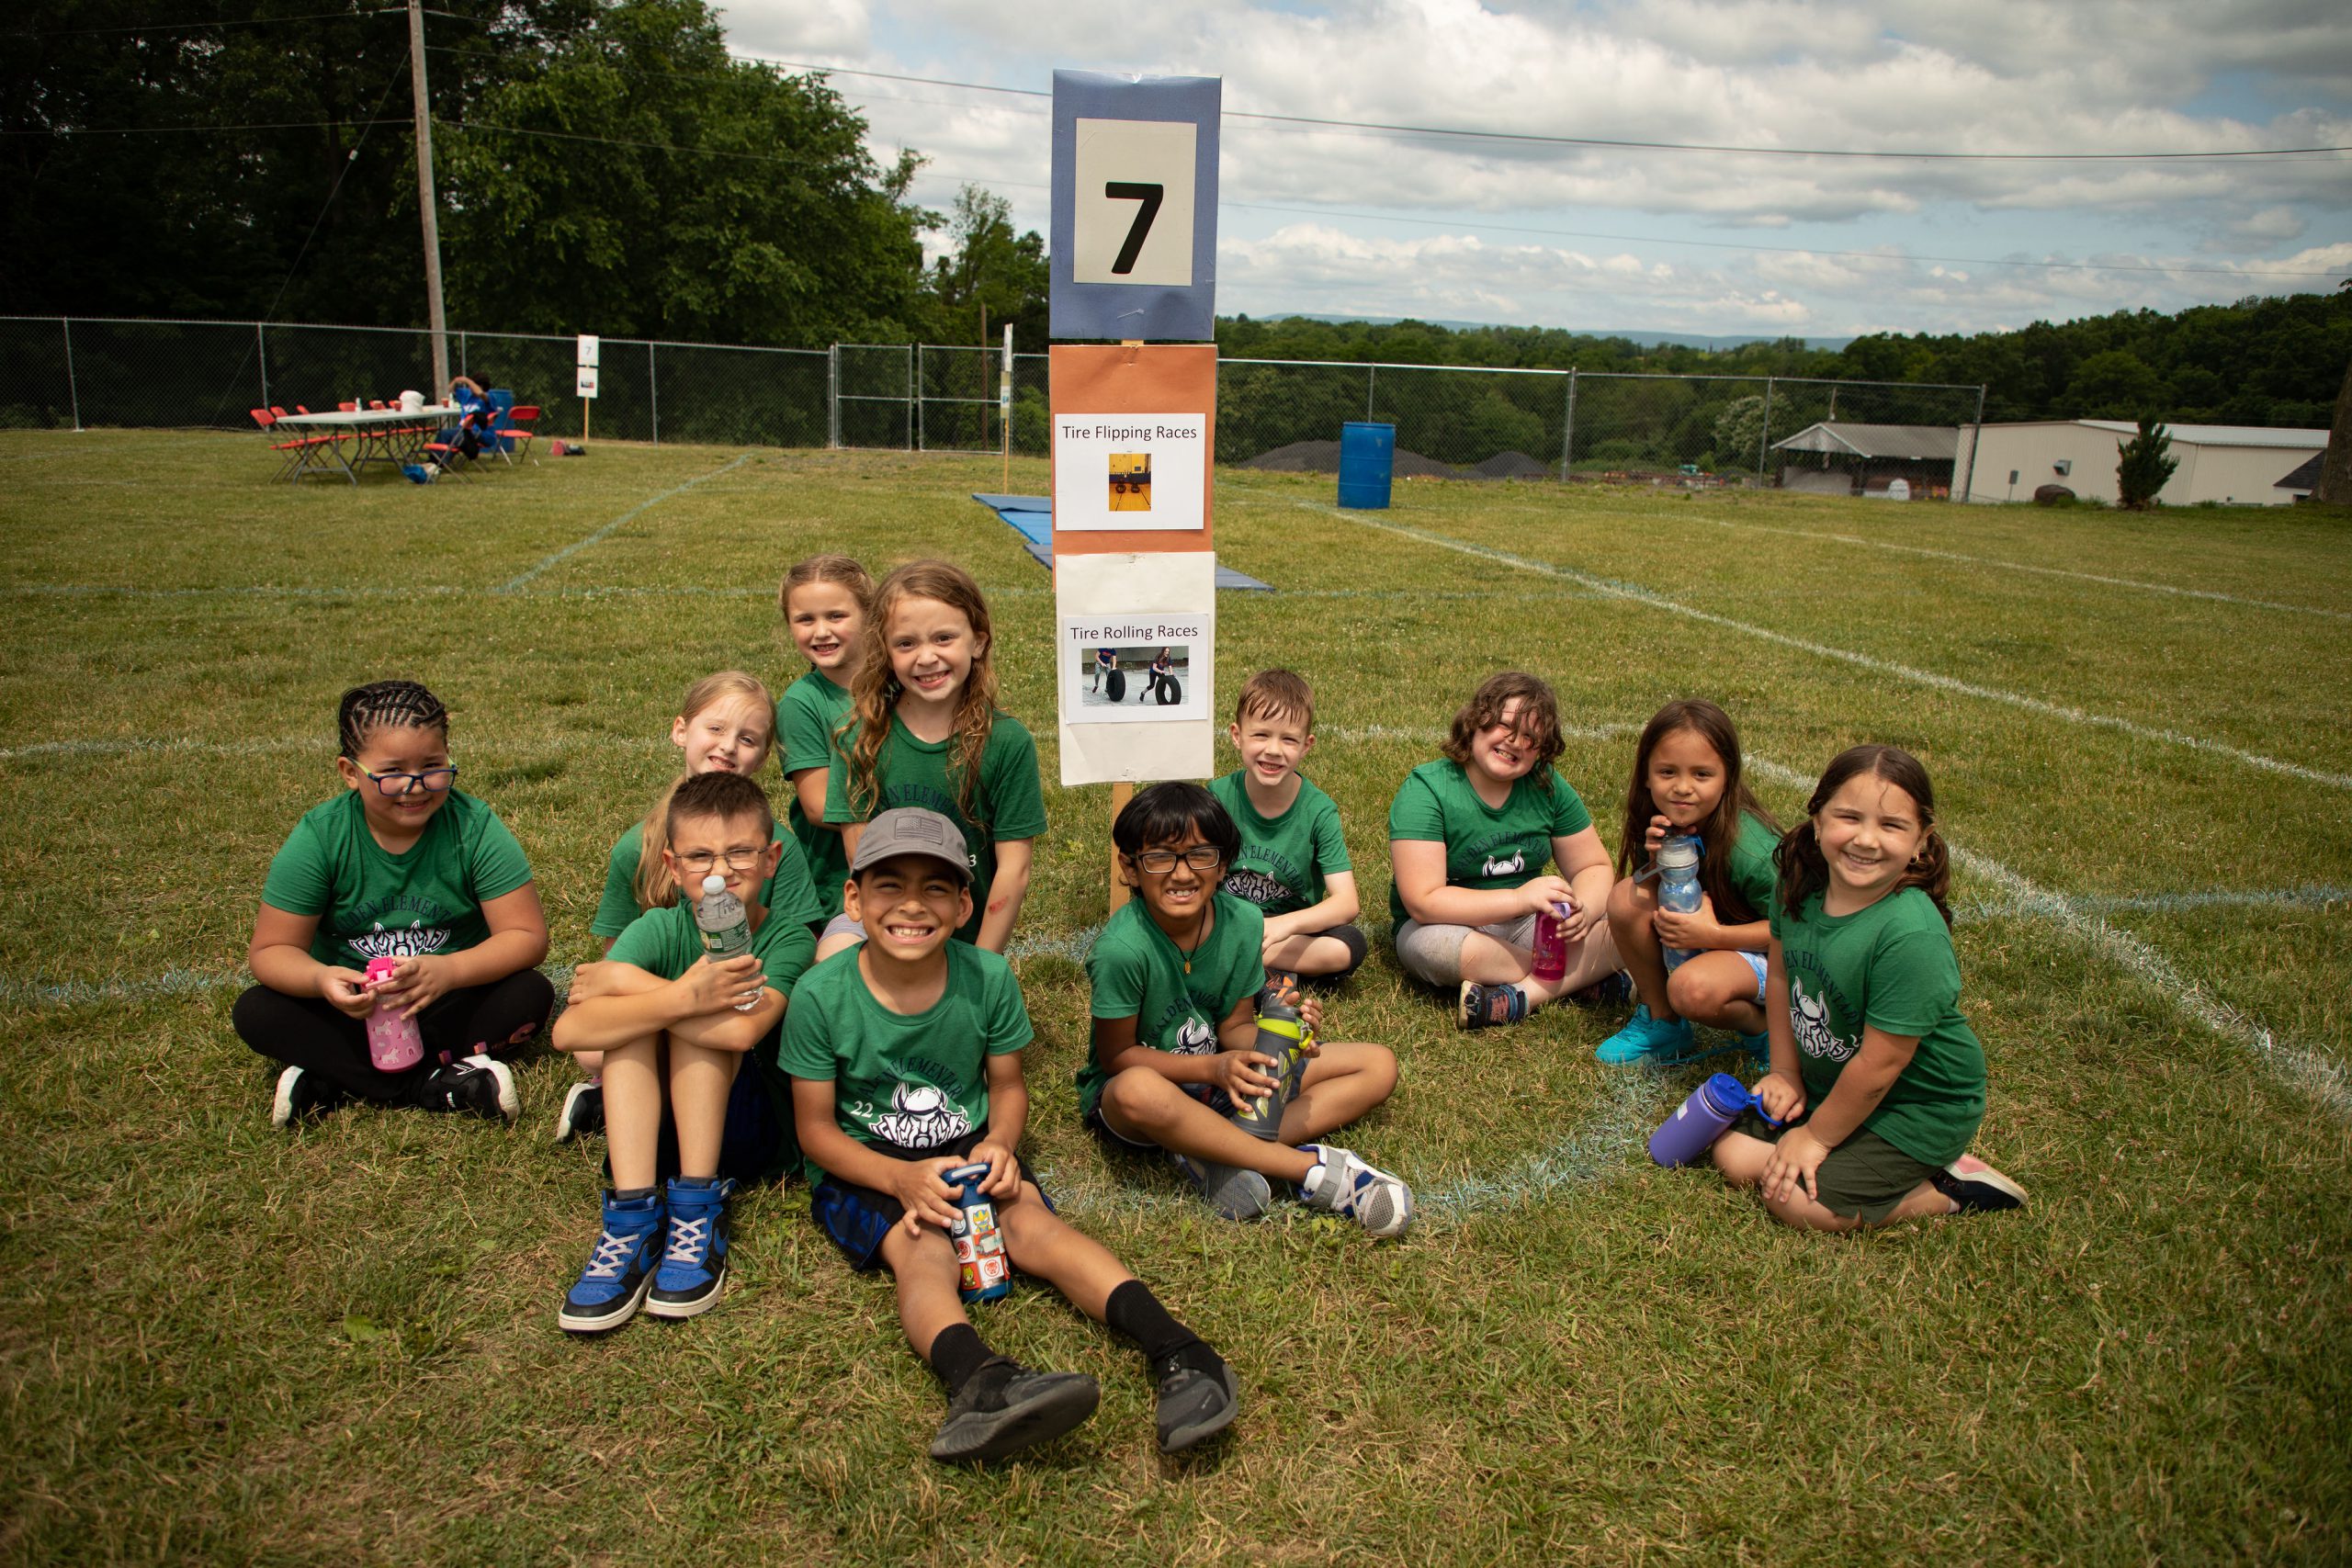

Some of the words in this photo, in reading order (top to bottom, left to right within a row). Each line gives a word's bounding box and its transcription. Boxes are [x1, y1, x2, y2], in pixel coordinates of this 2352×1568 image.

[1105, 181, 1164, 274] 7
[1062, 425, 1091, 439] Tire
[1095, 425, 1152, 442] Flipping
[1157, 425, 1197, 439] Races
[1069, 626, 1099, 640] Tire
[1103, 625, 1153, 641] Rolling
[1158, 625, 1198, 637] Races
[850, 1100, 874, 1118] 22
